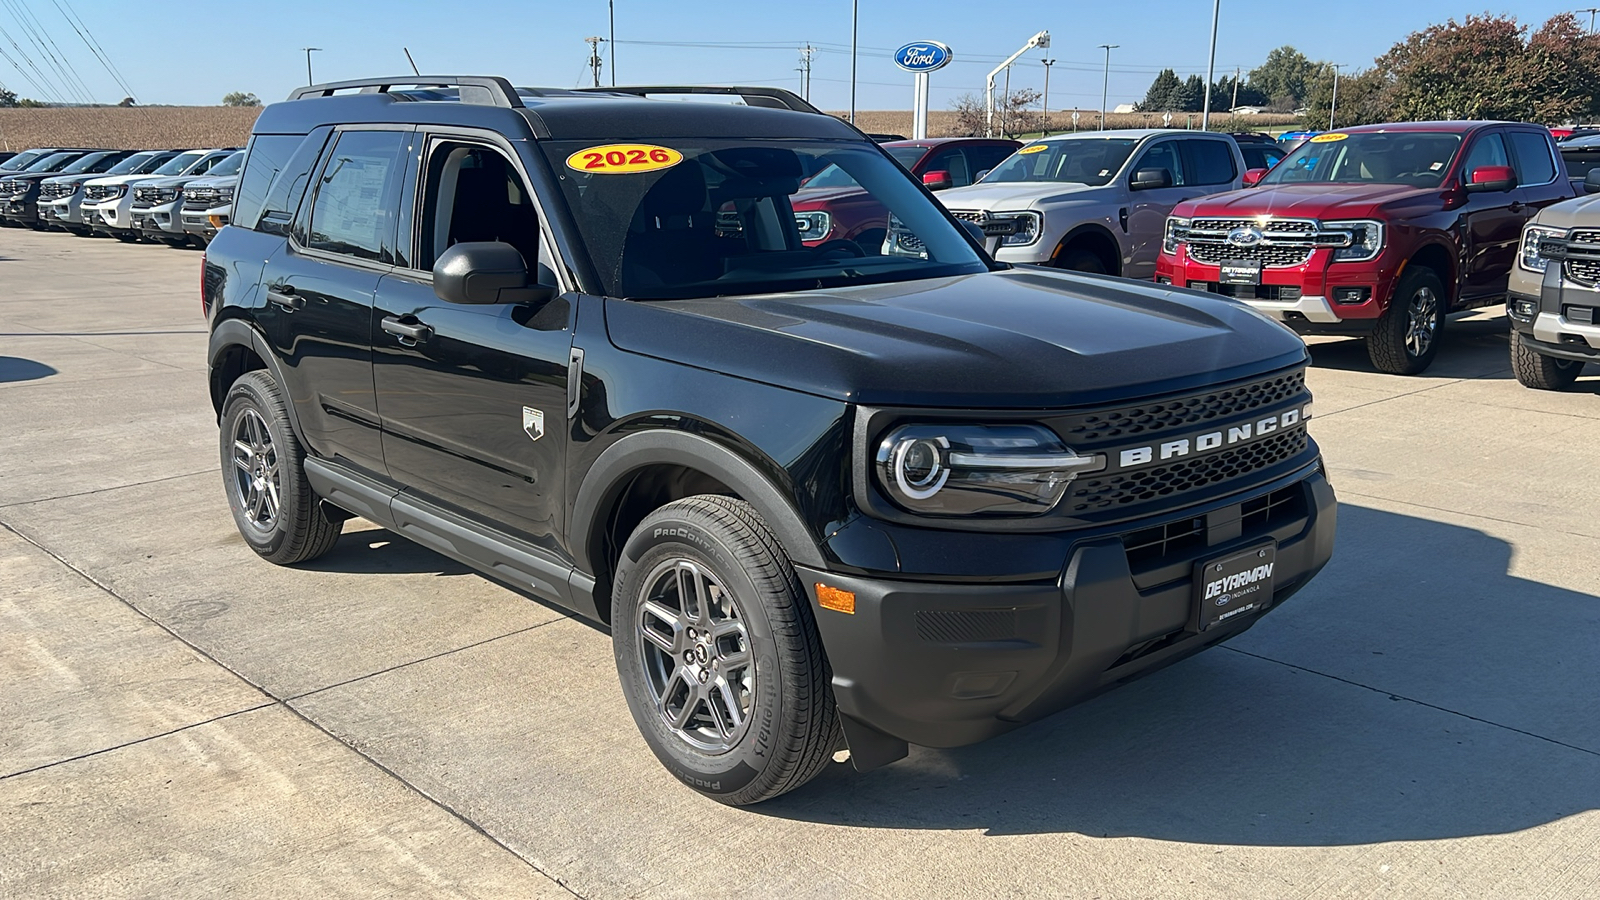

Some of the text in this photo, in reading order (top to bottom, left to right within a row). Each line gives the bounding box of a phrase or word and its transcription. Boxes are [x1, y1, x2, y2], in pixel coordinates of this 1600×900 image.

[903, 46, 936, 66] Ford
[583, 148, 671, 169] 2026
[1119, 408, 1299, 467] BRONCO
[1204, 562, 1274, 600] DEYARMAN
[1231, 584, 1260, 600] INDIANOLA
[756, 653, 777, 750] Continental
